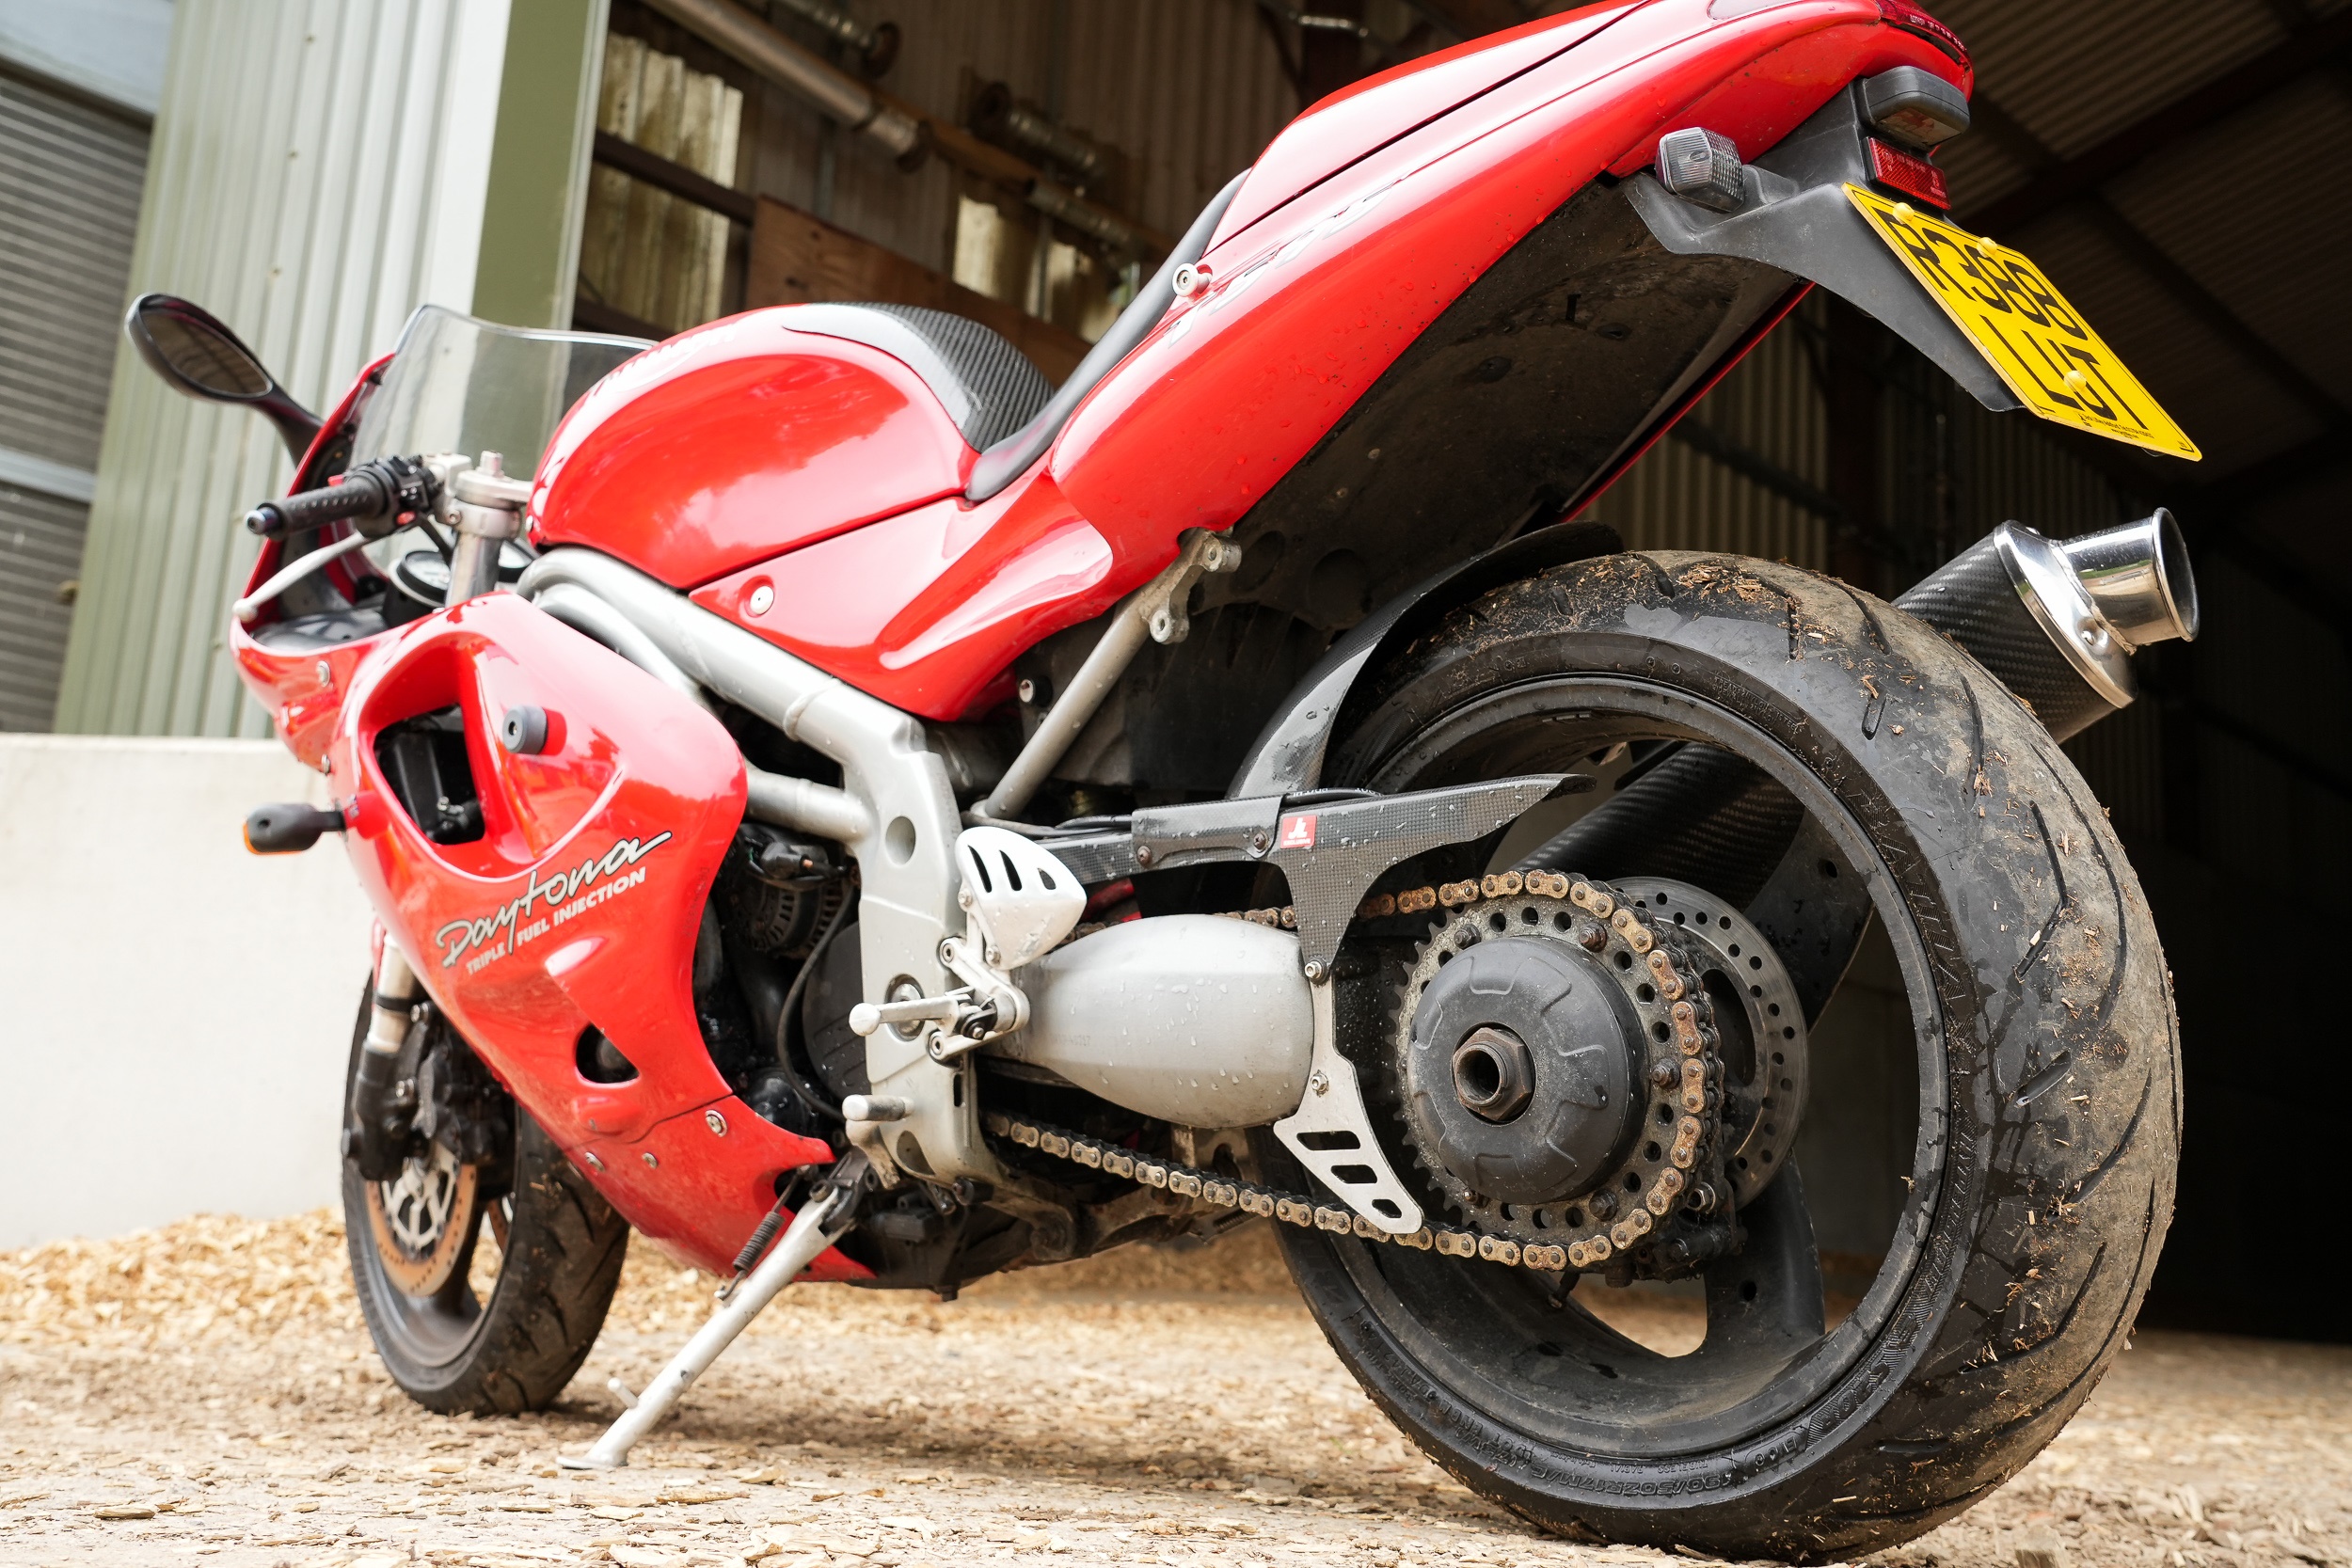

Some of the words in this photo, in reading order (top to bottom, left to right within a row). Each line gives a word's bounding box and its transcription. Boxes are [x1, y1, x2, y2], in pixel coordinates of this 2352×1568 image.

[1872, 206, 2089, 341] R388
[1980, 314, 2150, 430] LUT
[436, 831, 673, 969] Daytona
[466, 942, 506, 975] TRIPLE
[516, 918, 550, 947] FUEL
[553, 866, 647, 927] INJECTION
